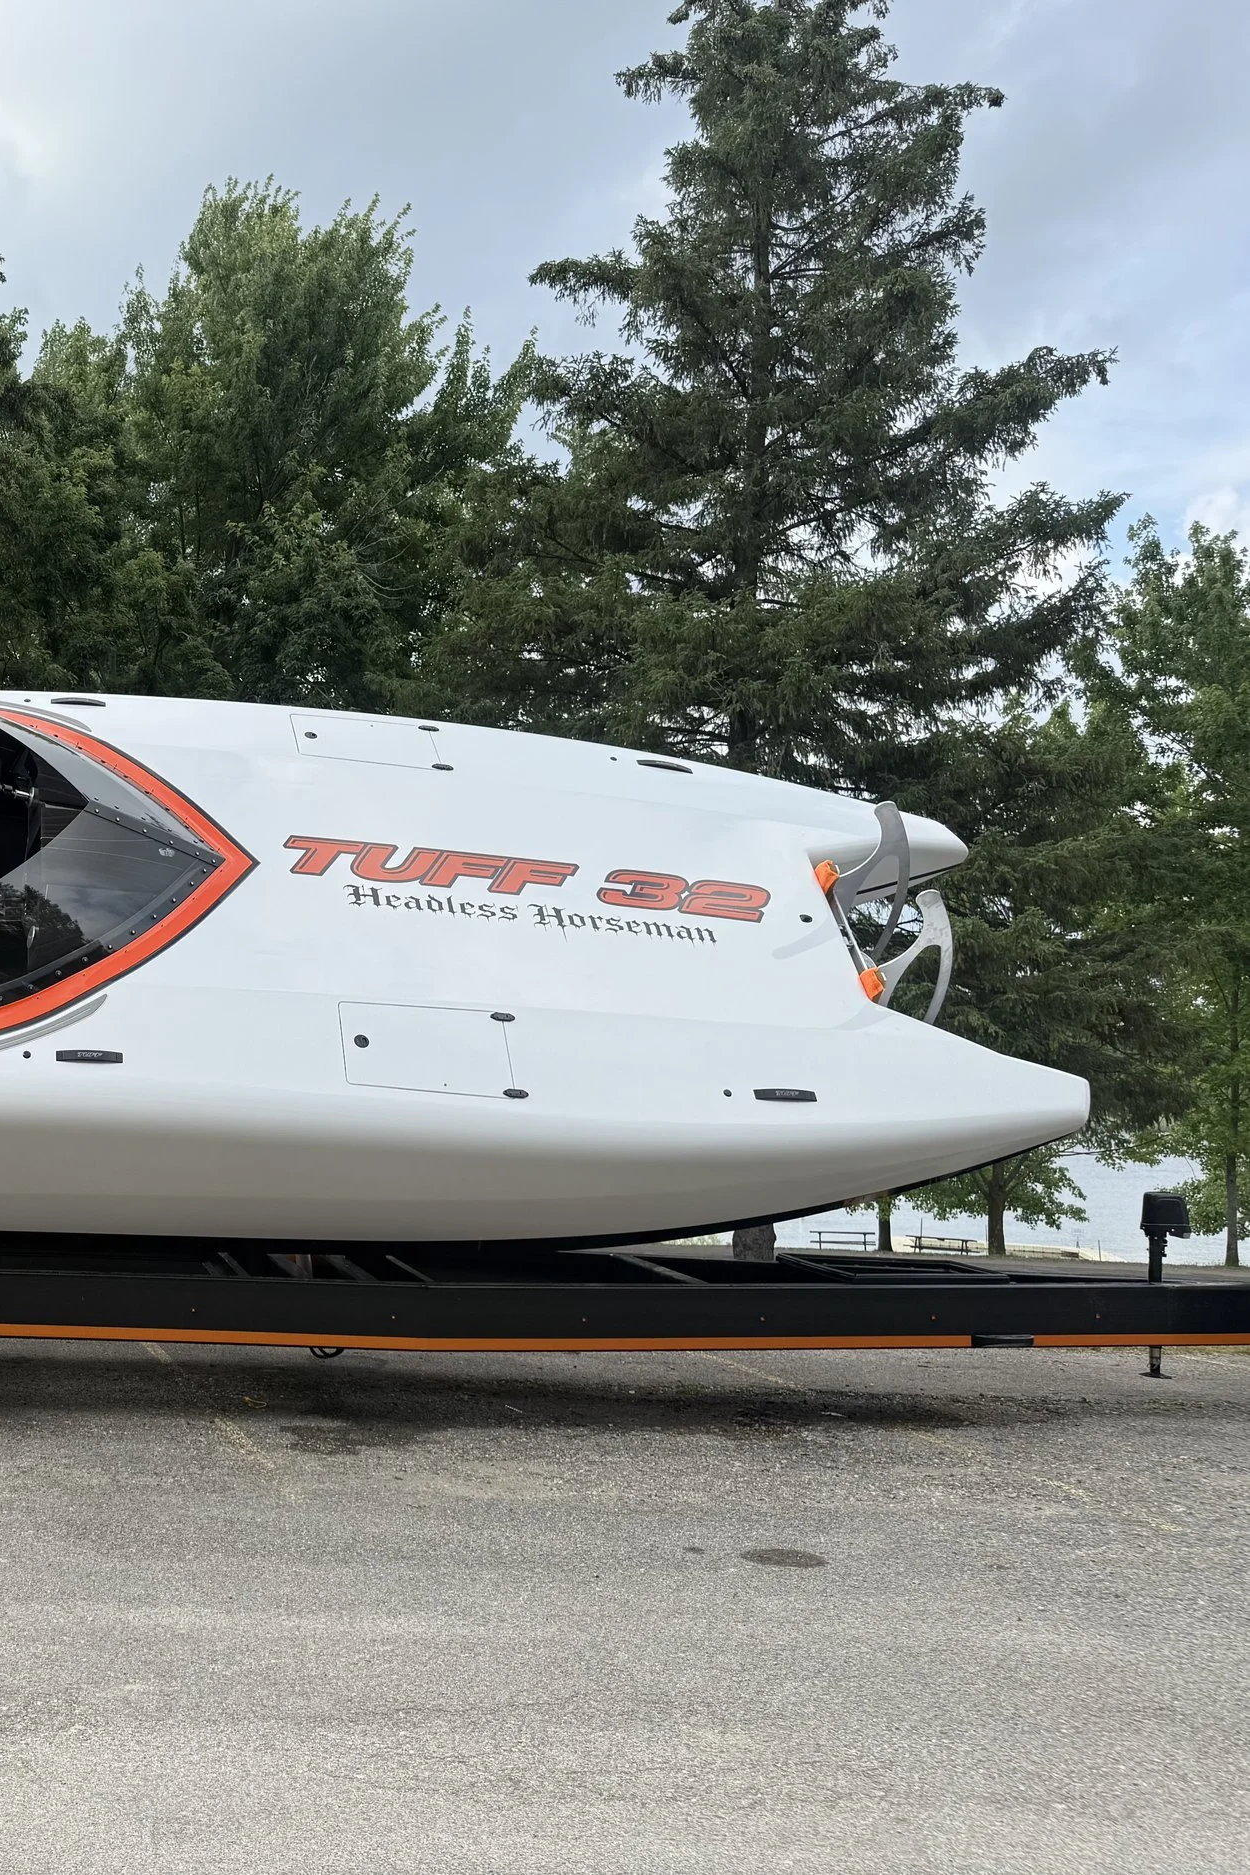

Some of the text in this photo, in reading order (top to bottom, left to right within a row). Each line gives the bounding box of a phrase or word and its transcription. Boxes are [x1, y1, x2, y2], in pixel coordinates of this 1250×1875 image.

[282, 834, 769, 923] TUFF 32
[343, 884, 718, 947] Headless Horseman
